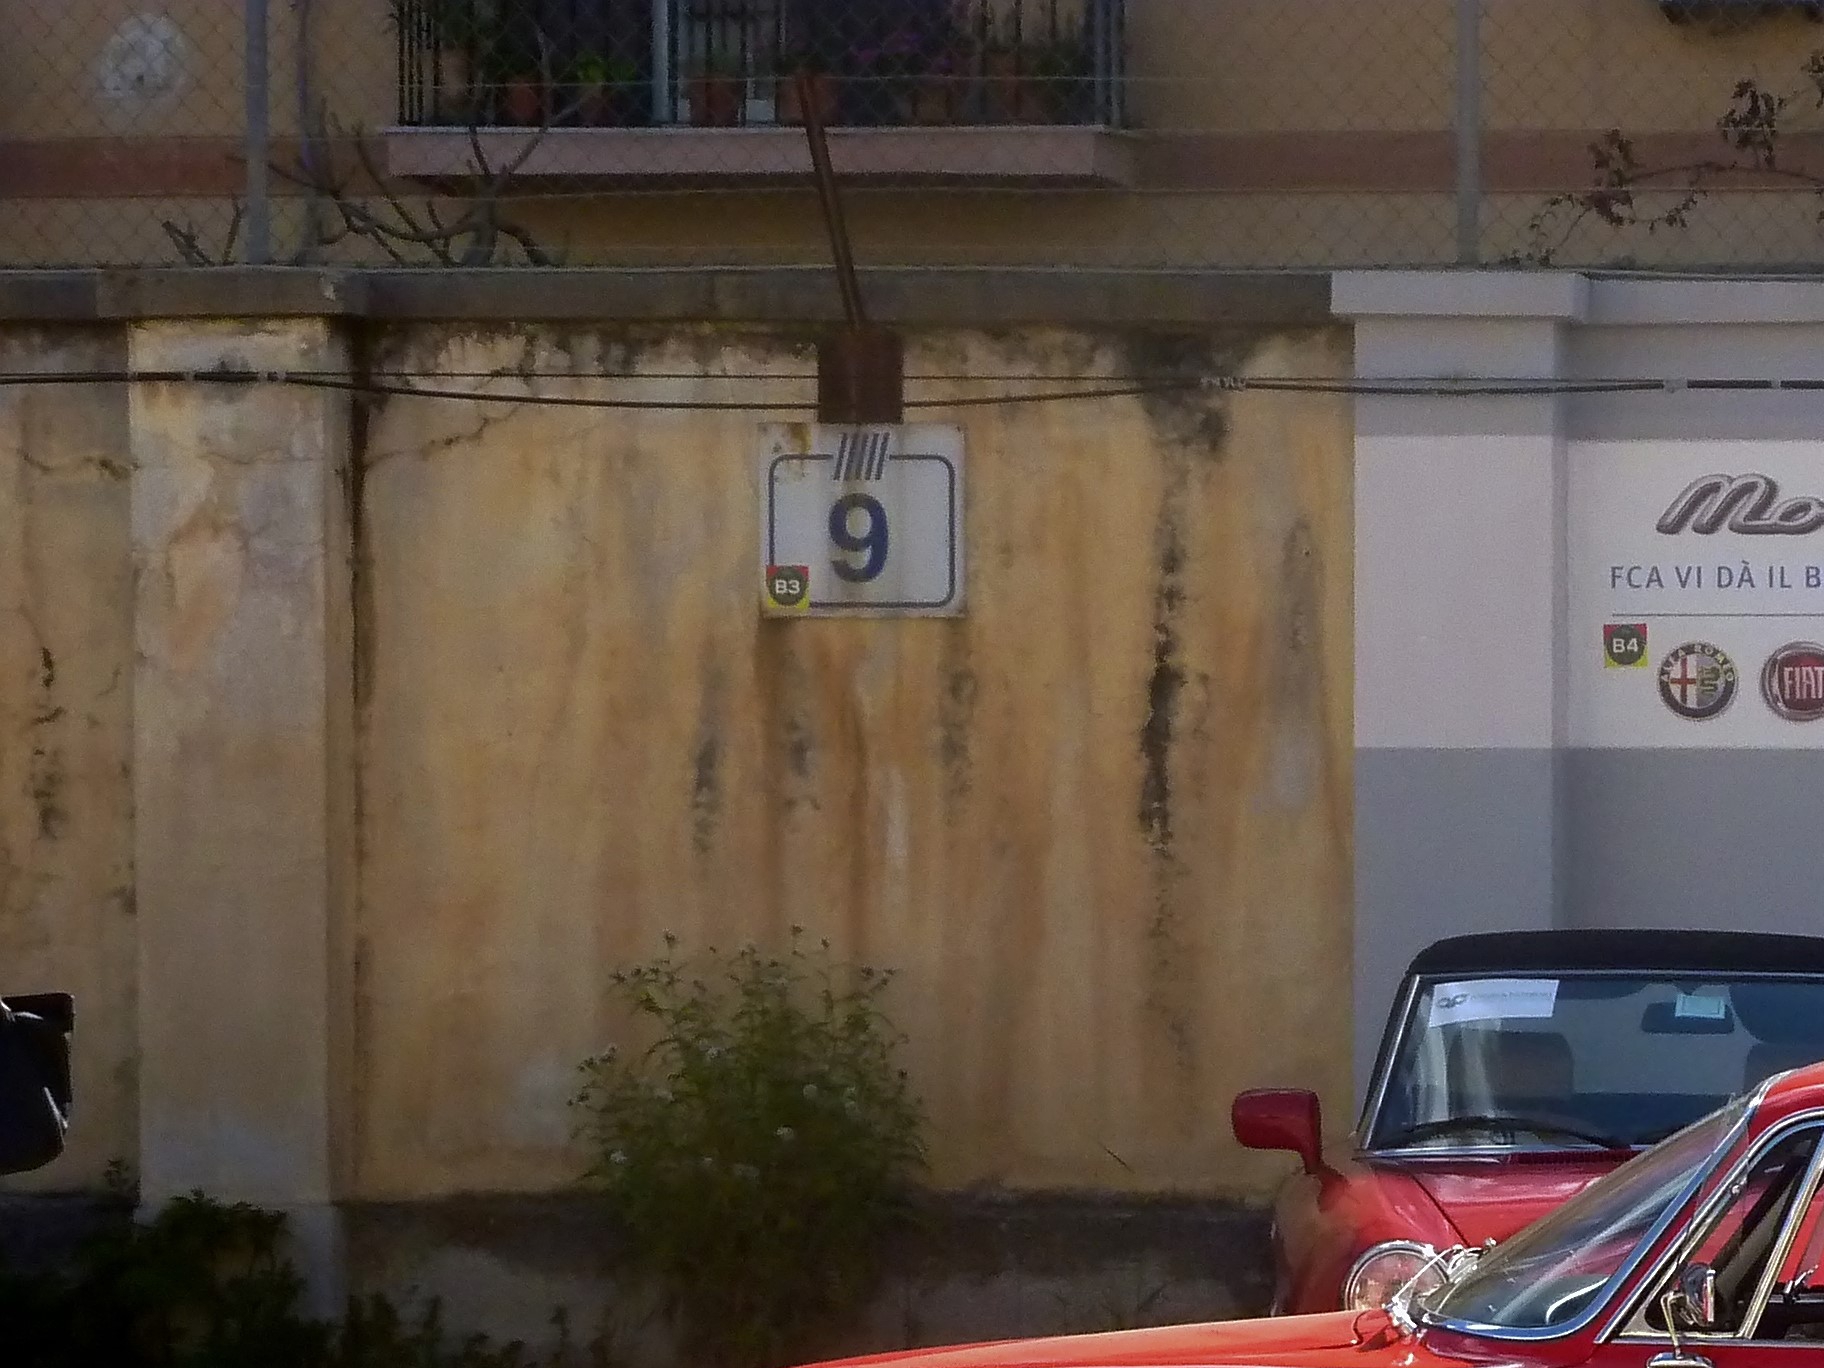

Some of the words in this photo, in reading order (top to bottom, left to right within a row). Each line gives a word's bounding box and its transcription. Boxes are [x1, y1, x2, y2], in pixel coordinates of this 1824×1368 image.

[829, 492, 889, 584] 9
[774, 579, 801, 595] B3
[1609, 564, 1665, 590] FCA
[1674, 564, 1702, 590] VI
[1716, 559, 1756, 590] DÀ
[1767, 564, 1793, 590] IL
[1612, 637, 1639, 653] B4
[1660, 648, 1688, 683] ALFA
[1693, 643, 1736, 683] ROMEO
